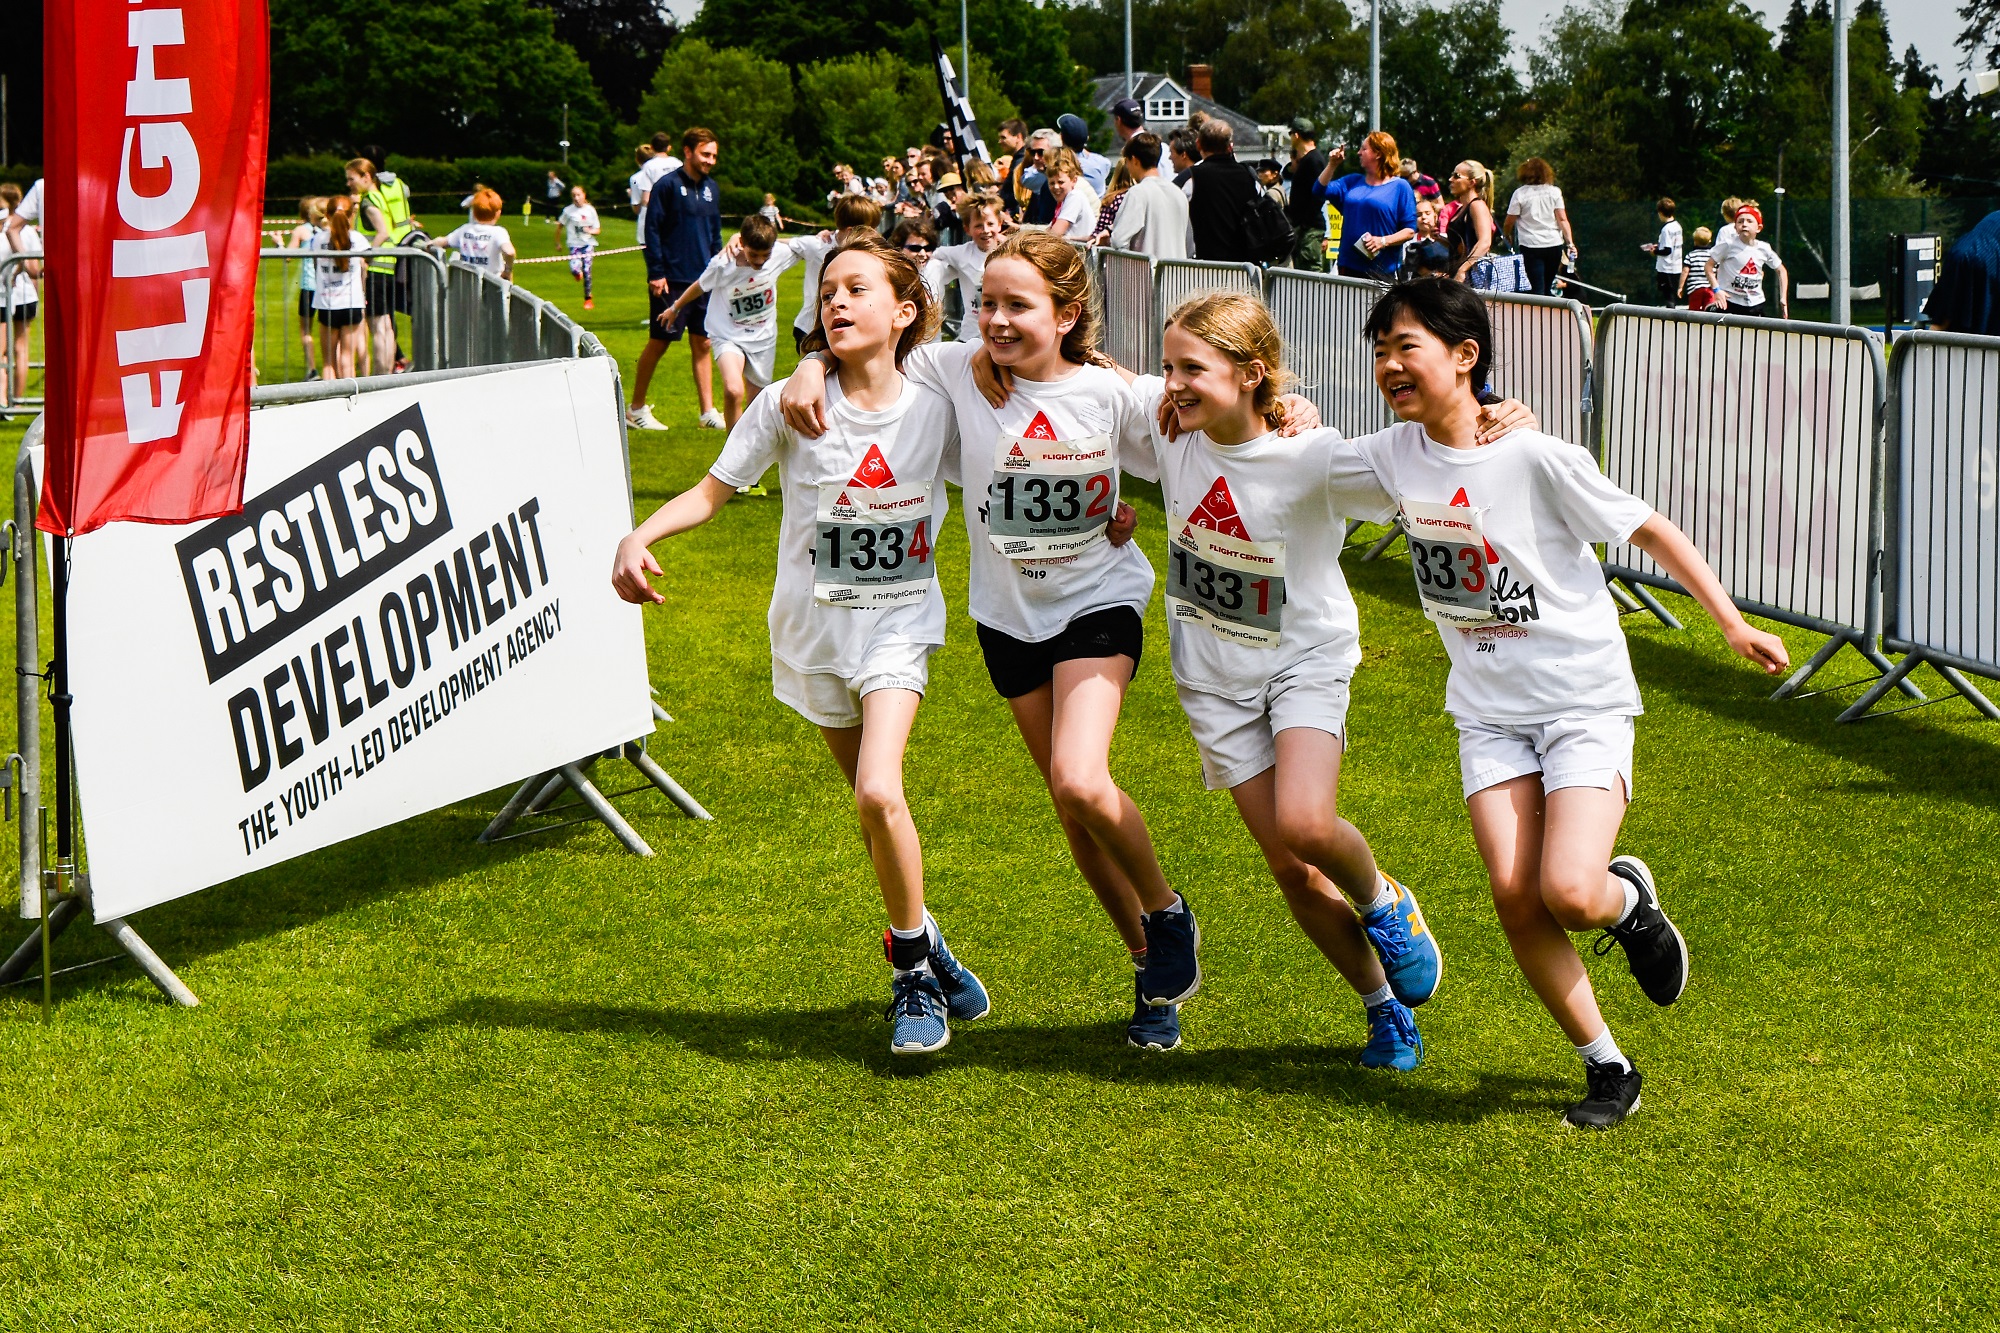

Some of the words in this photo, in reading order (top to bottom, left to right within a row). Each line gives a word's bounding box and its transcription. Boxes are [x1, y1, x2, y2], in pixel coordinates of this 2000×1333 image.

[112, 0, 211, 444] FLIGH
[732, 288, 774, 315] 1352
[1042, 453, 1074, 461] FLIGHT
[1075, 449, 1106, 461] CENTRE
[868, 502, 898, 510] FLIGHT
[899, 496, 926, 507] CENTRE
[997, 474, 1111, 523] 1332
[1415, 517, 1442, 527] FLIGHT
[1443, 521, 1473, 531] CENTRE
[191, 428, 438, 656] RESTLESS
[822, 521, 931, 571] 1334
[1004, 545, 1036, 555] DEVELOPMENT
[1039, 554, 1079, 566] Holidays
[1209, 543, 1239, 557] FLIGHT
[1240, 553, 1275, 564] CENTRE
[855, 575, 881, 583] Dreaming
[882, 574, 903, 582] Dragons
[1021, 566, 1047, 580] 2019
[1173, 550, 1271, 616] 1331
[829, 594, 861, 602] DEVELOPMENT
[872, 588, 927, 600] #TriFlightCentre
[1211, 623, 1269, 642] #TriFlightCentre
[227, 497, 550, 794] DEVELOPMENT
[238, 801, 279, 856] THE
[279, 731, 386, 819] YOUTH-LED
[390, 643, 504, 753] DEVELOPMENT
[506, 598, 563, 671] AGENCY
